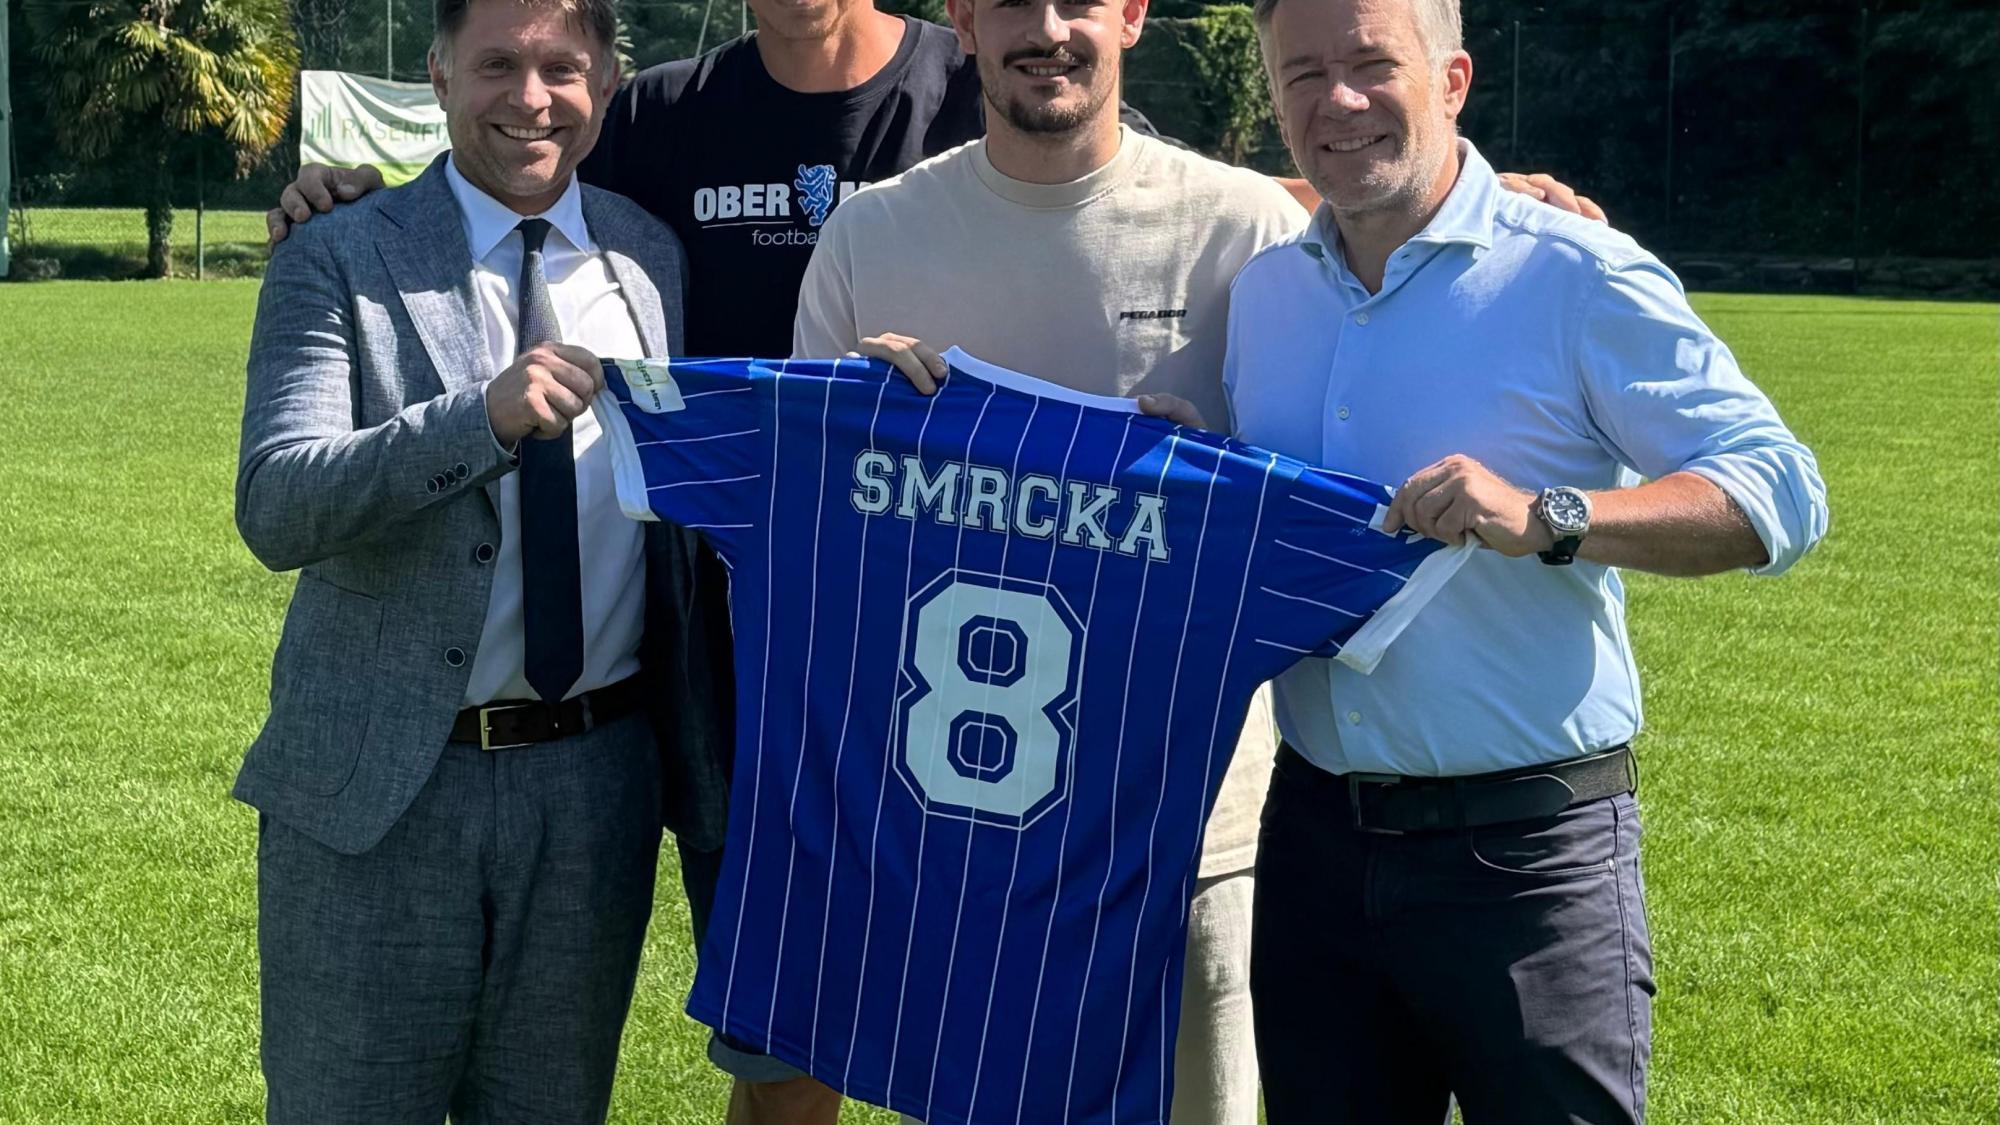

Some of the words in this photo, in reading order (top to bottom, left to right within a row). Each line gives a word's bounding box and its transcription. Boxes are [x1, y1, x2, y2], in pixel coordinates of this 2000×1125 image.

[693, 183, 791, 222] OBER
[752, 229, 818, 246] footba
[850, 448, 1171, 563] SMRCKA
[892, 567, 1087, 831] 8
